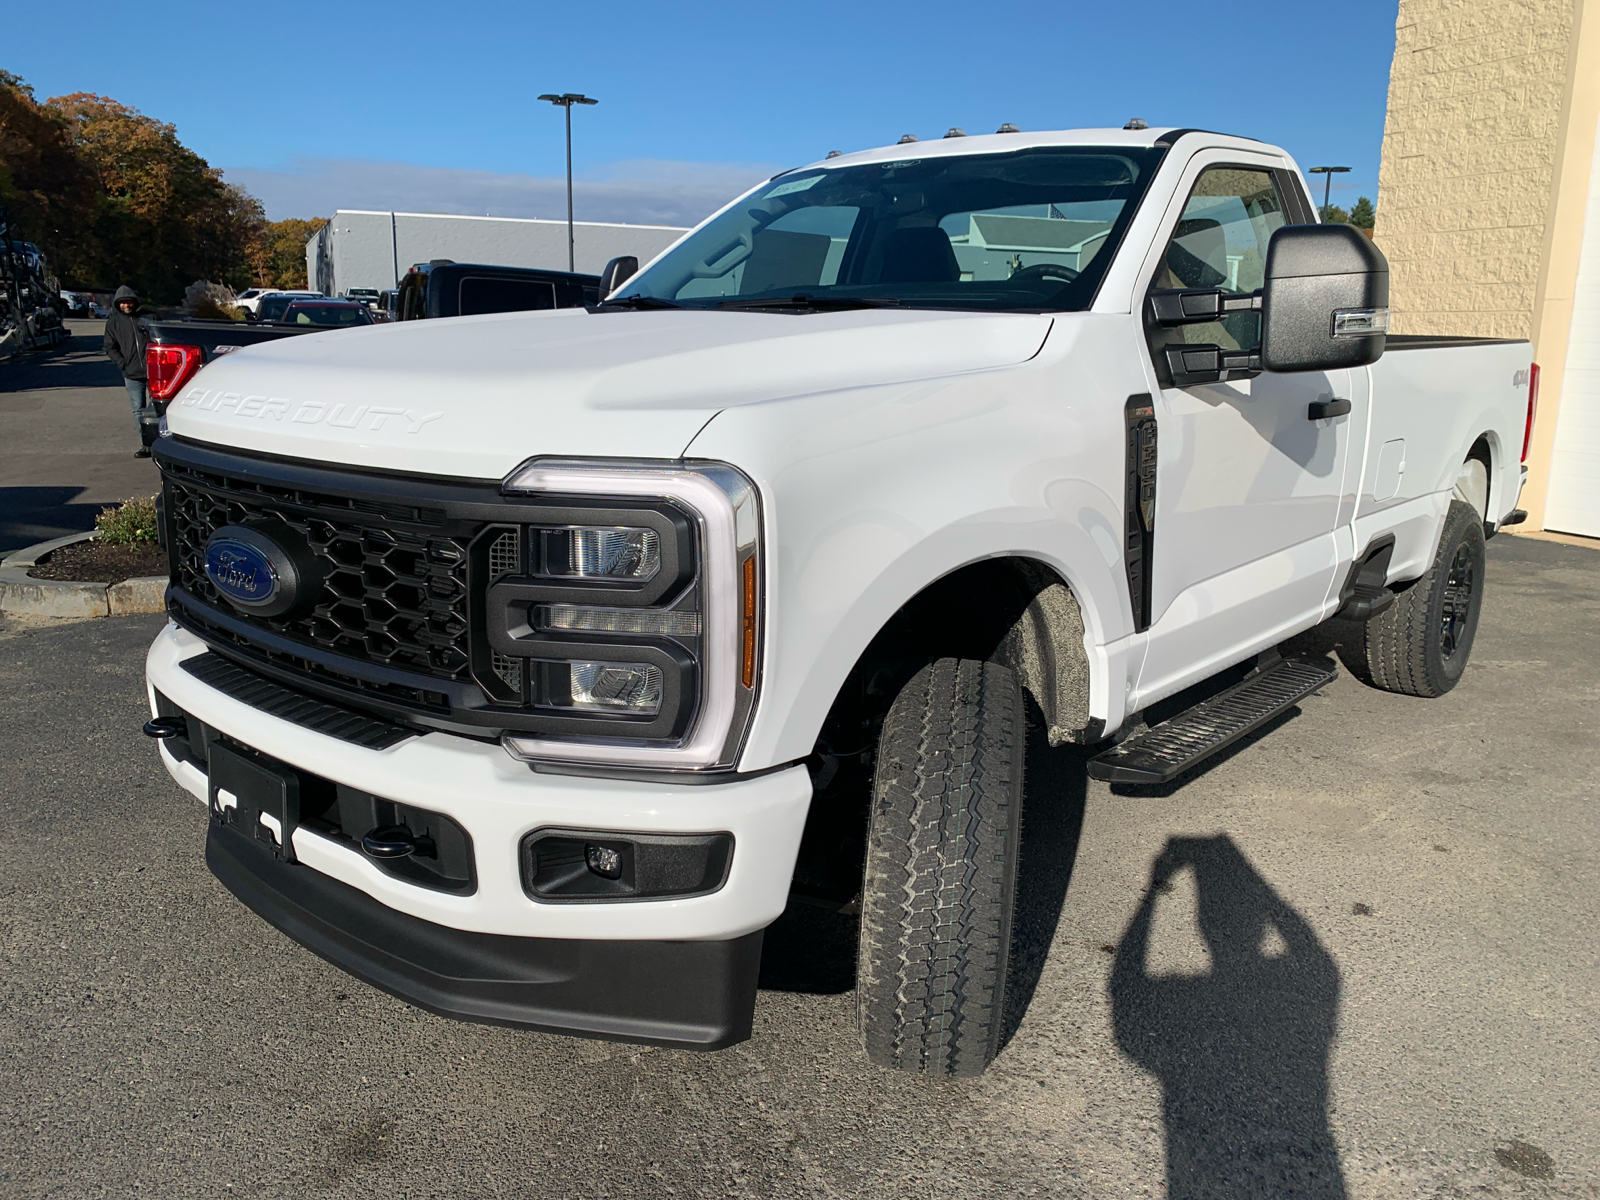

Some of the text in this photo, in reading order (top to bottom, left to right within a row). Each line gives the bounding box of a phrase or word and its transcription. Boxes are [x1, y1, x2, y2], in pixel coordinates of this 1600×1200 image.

[181, 387, 445, 434] SUPER DUTY
[217, 550, 258, 593] Ford
